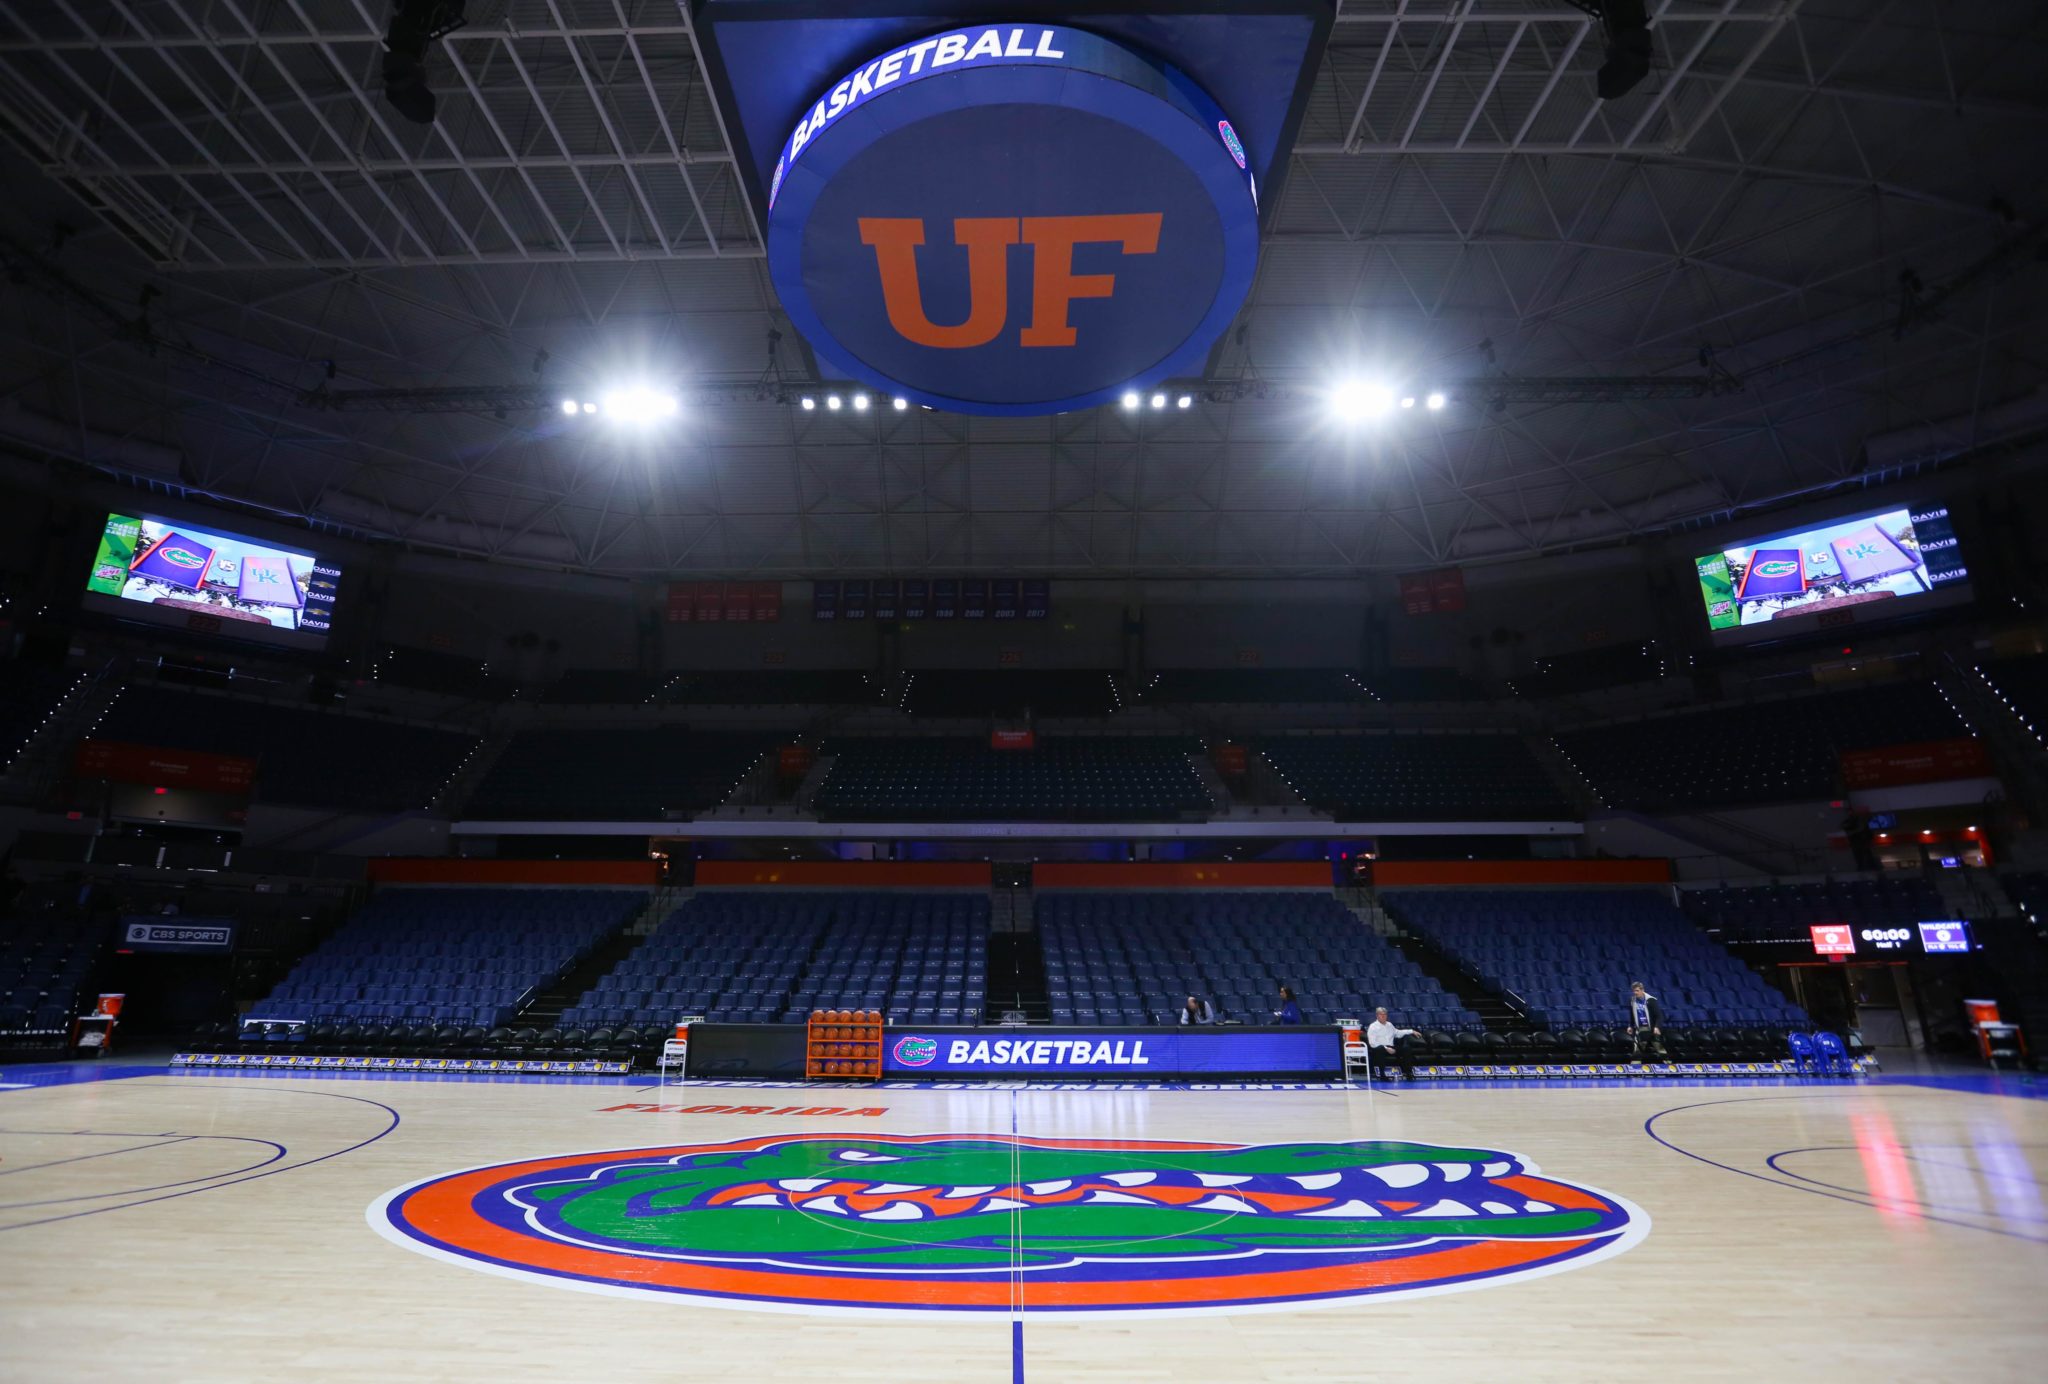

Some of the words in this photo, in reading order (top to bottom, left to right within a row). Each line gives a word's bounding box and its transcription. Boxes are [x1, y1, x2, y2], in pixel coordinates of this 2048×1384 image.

[790, 29, 1065, 162] BASKETBALL
[858, 213, 1163, 349] UF
[1911, 509, 1949, 523] DAVIS
[1920, 538, 1958, 552] DAVIS
[1811, 552, 1829, 564] VS
[219, 560, 236, 572] VS
[313, 566, 342, 577] DAVIS
[1929, 568, 1968, 582] DAVIS
[307, 592, 336, 603] DAVIS
[301, 619, 331, 630] DAVIS
[151, 929, 176, 939] CBS
[178, 931, 225, 940] SPORTS
[1861, 928, 1910, 941] 60:00
[948, 1040, 1149, 1065] BASKETBALL
[596, 1103, 889, 1117] FLORIDA
